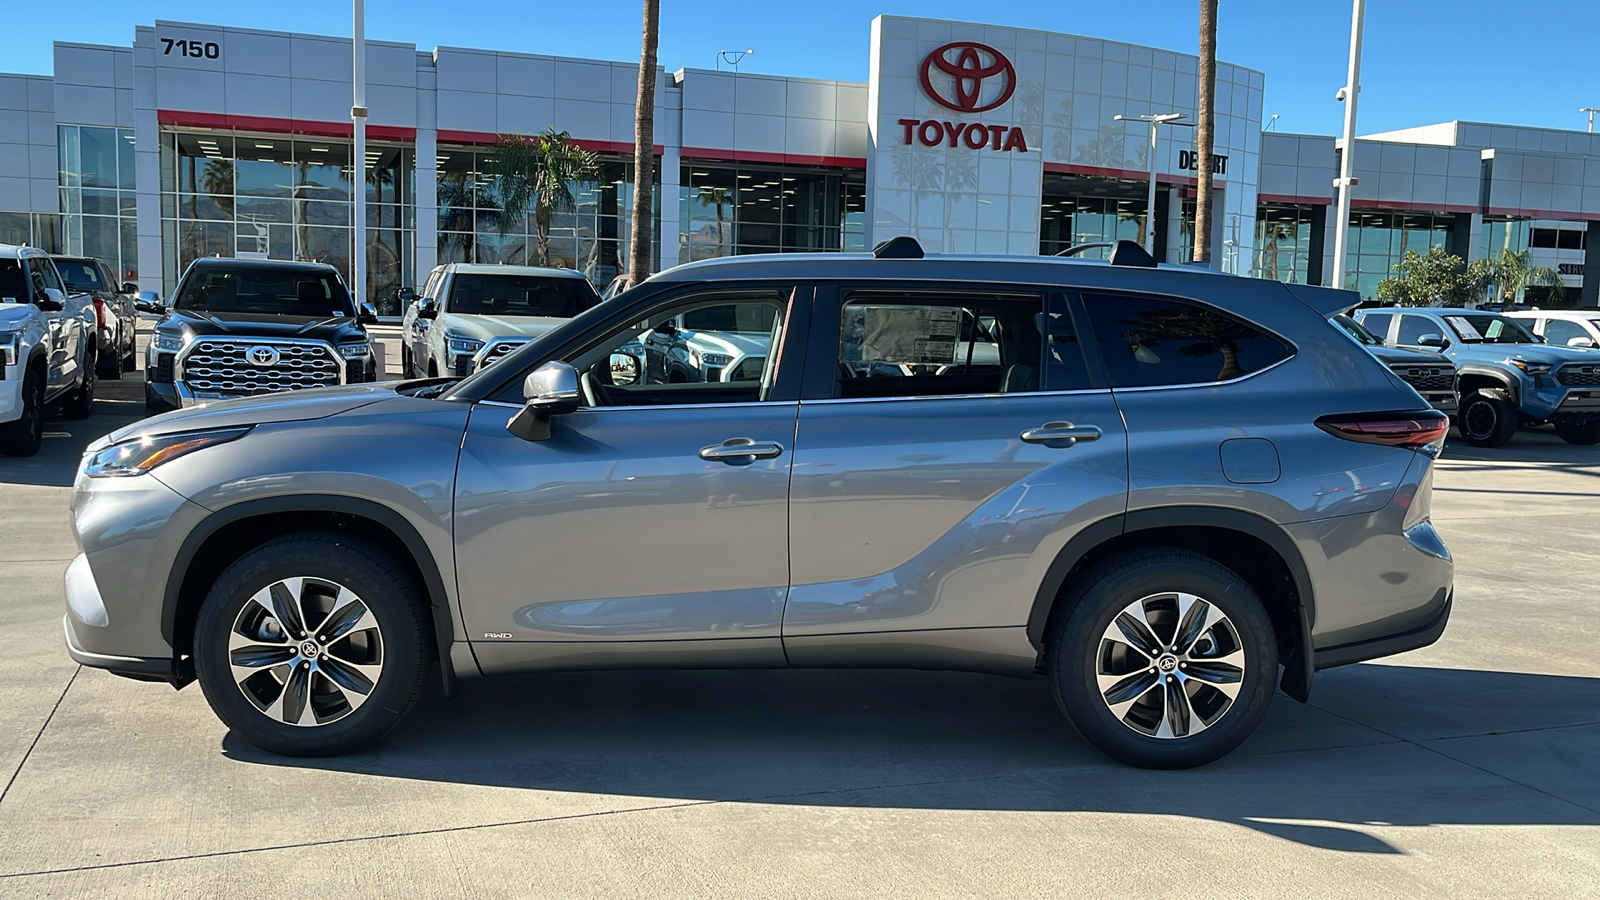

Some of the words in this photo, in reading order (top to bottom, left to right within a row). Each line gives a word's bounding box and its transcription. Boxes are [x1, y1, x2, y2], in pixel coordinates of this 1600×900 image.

[160, 37, 220, 59] 7150
[898, 118, 1028, 153] TOYOTA
[1178, 149, 1229, 175] DERT
[484, 631, 513, 639] AWD
